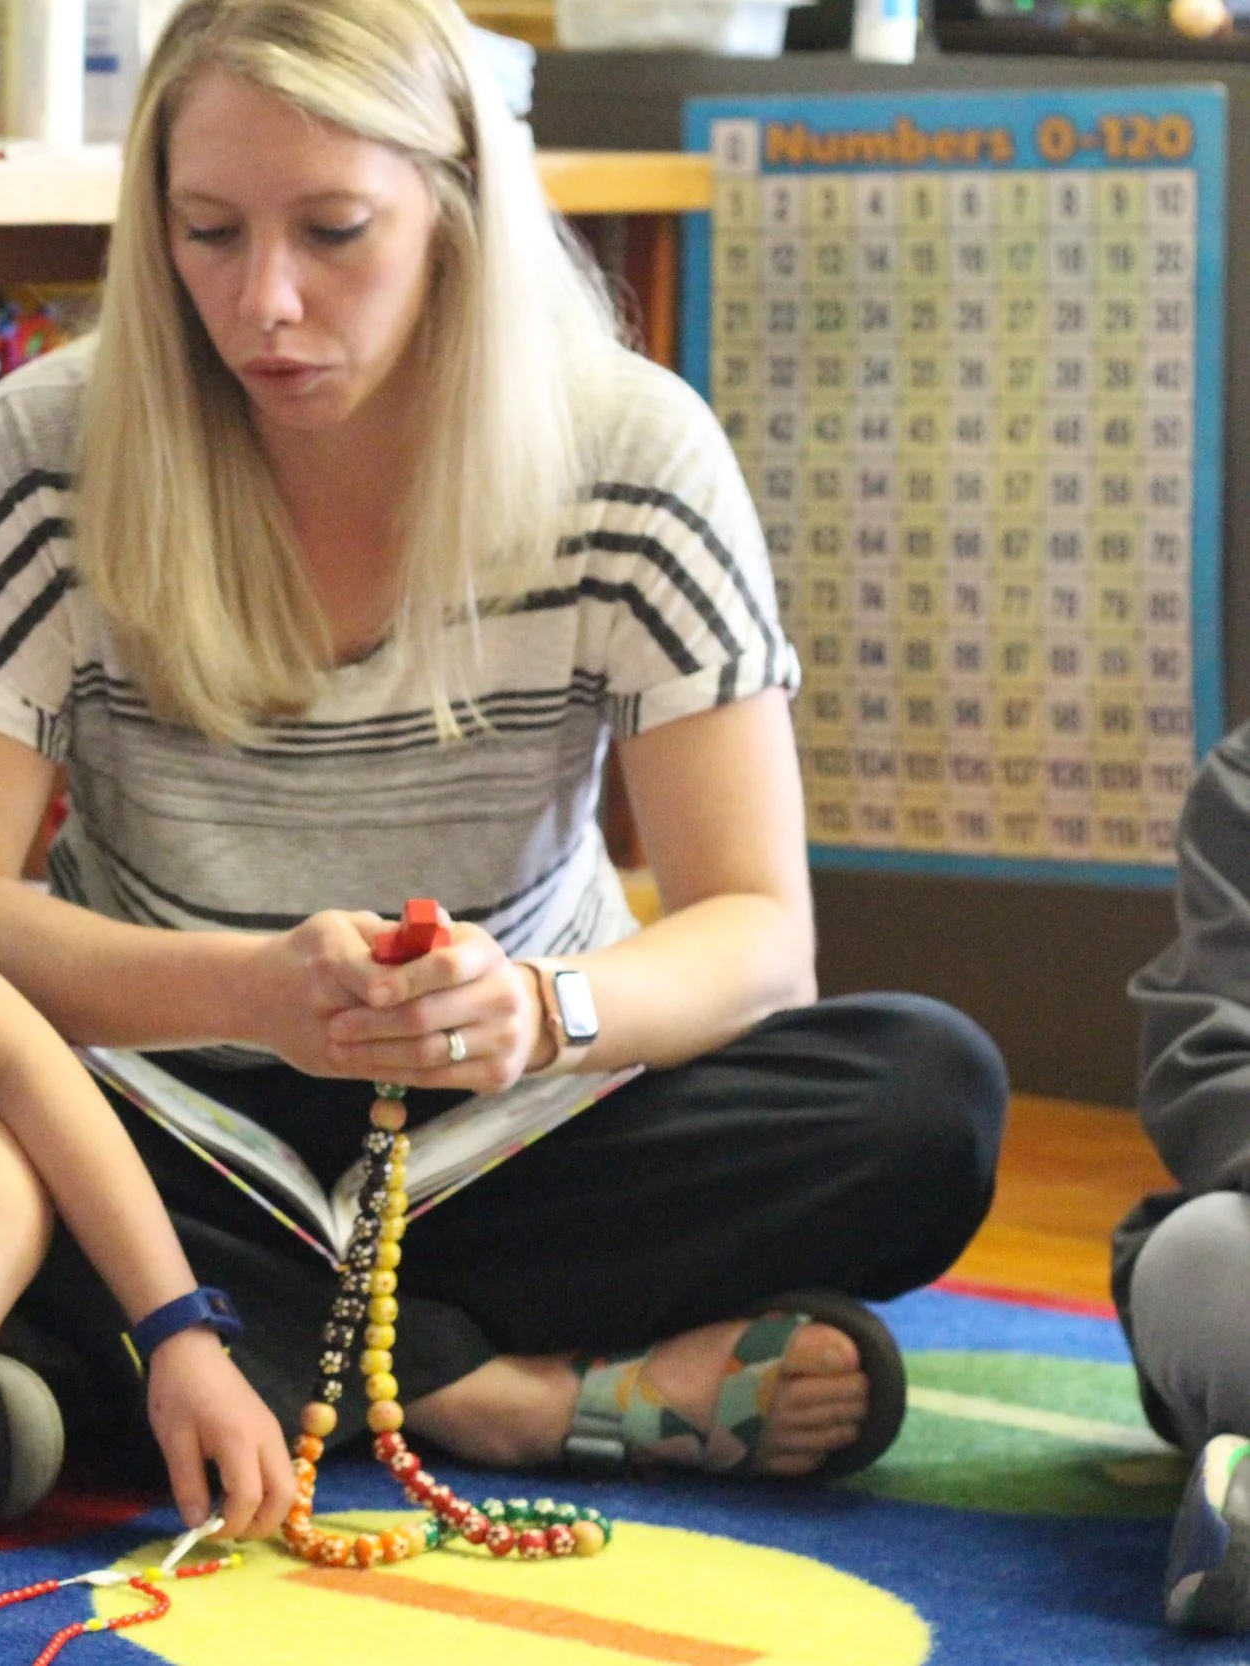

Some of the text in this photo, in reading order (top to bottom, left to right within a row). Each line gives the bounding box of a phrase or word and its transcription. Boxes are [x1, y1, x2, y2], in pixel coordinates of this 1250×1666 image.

[766, 114, 1194, 163] Numbers 0-120
[773, 189, 789, 224] 2
[868, 191, 884, 216] 4
[1013, 183, 1028, 217] 7
[1156, 185, 1182, 214] 10
